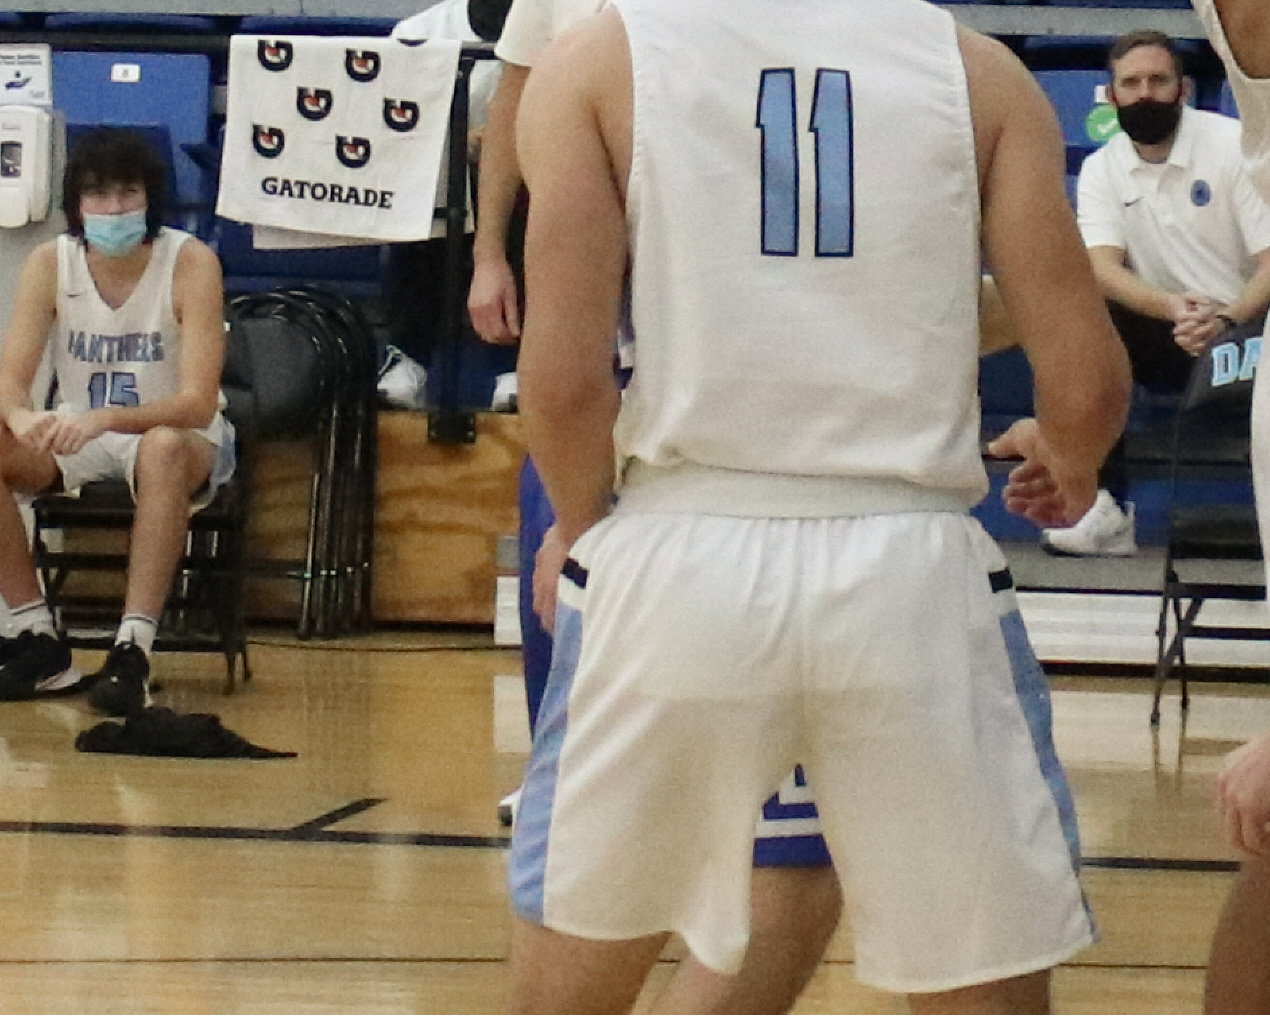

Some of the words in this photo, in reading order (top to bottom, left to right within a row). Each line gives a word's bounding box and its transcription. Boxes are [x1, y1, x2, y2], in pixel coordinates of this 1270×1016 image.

[755, 66, 854, 257] 11
[261, 176, 394, 210] GATORADE
[87, 372, 140, 409] 15
